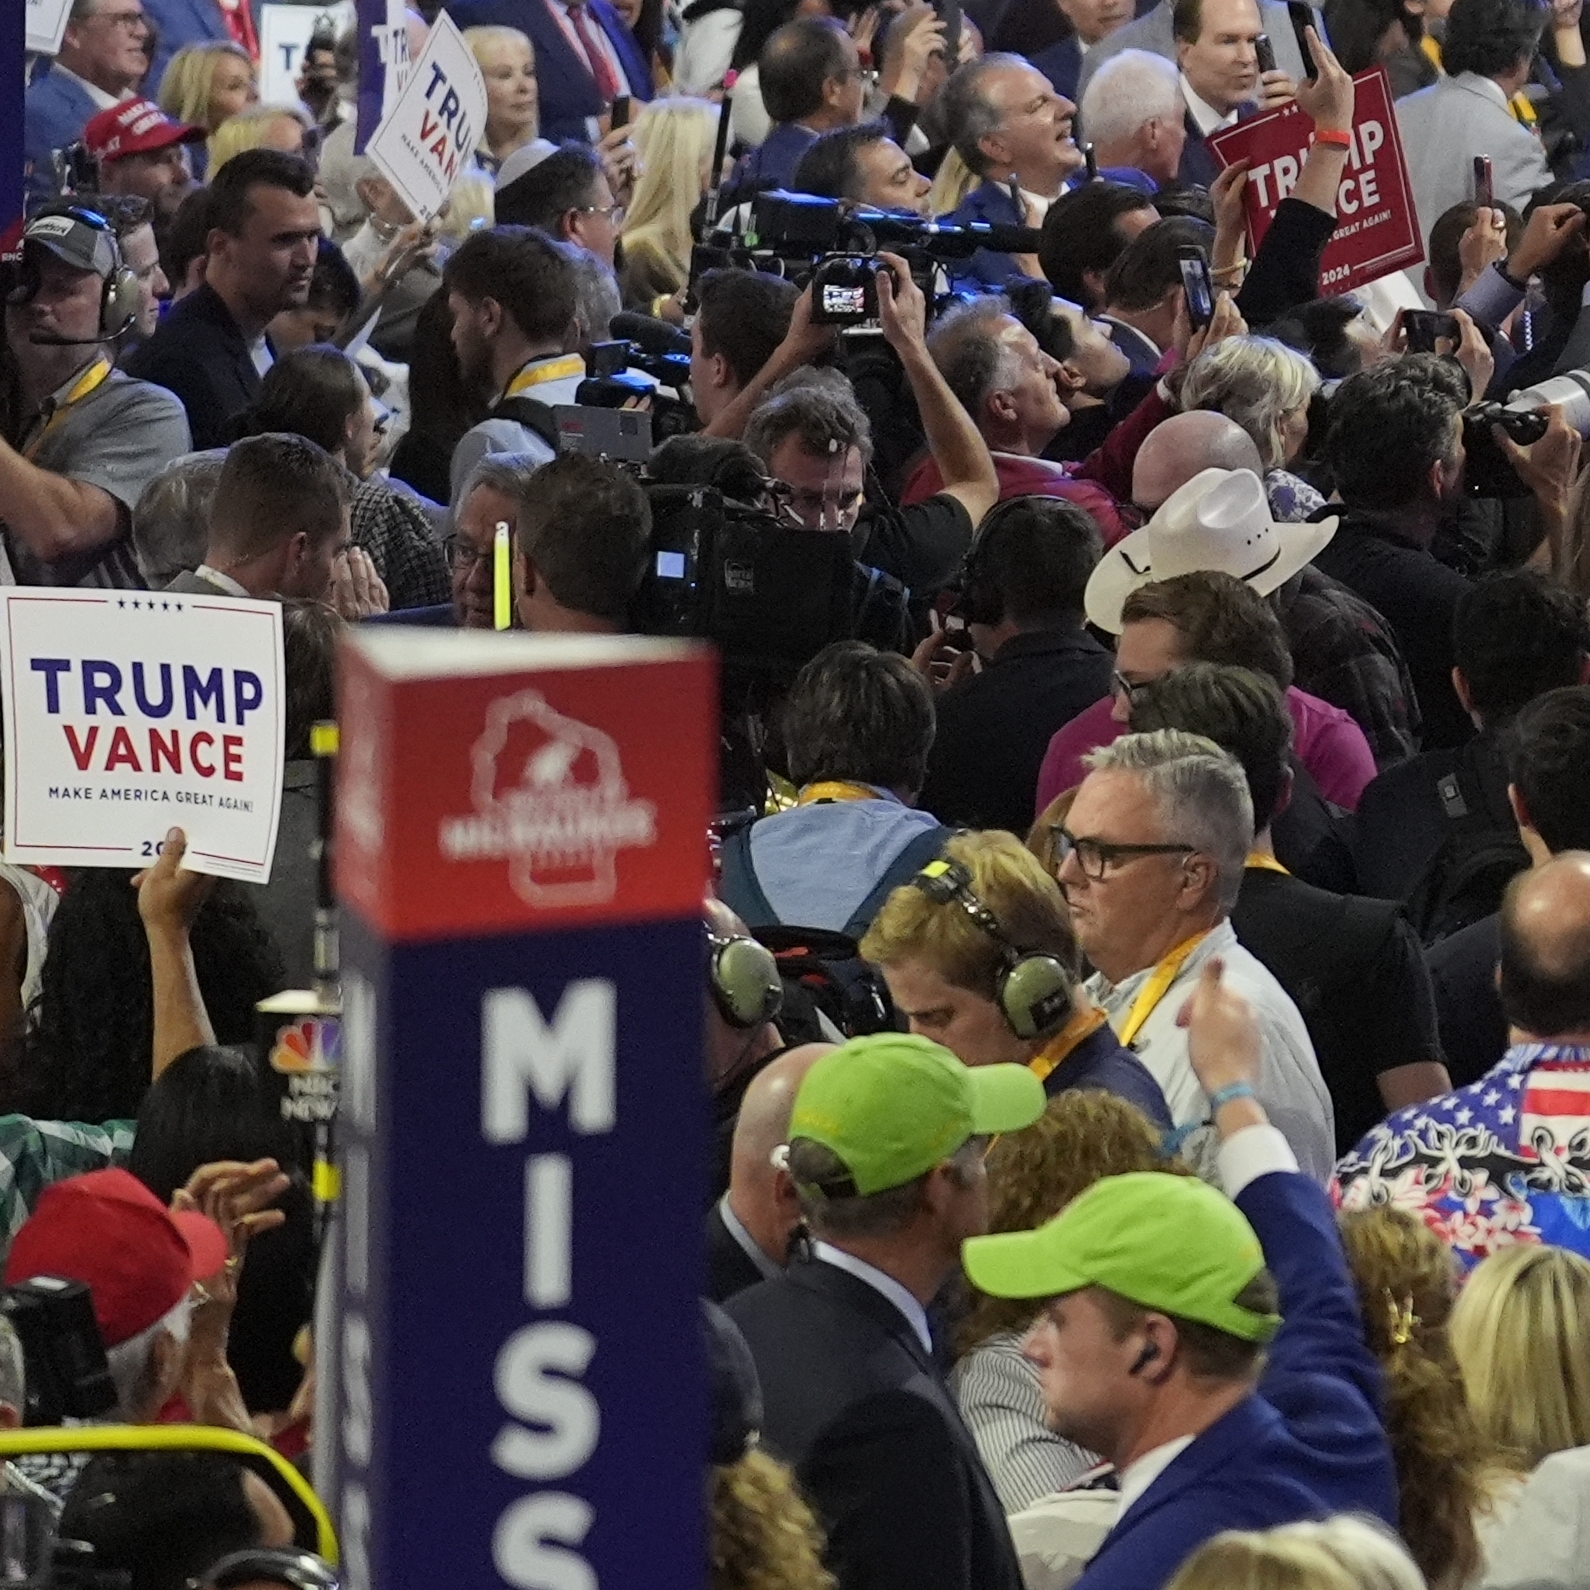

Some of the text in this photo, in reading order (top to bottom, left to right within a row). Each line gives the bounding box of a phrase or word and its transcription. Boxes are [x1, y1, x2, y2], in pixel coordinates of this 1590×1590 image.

[424, 60, 473, 154] TRU
[419, 109, 458, 181] VAN
[1247, 119, 1384, 208] TRP
[1333, 209, 1392, 243] GREAT AGAIN!
[1321, 263, 1351, 286] 2024
[30, 658, 263, 726] TRUMP
[62, 724, 244, 782] VANCE
[49, 787, 254, 813] MAKE AMERICA GREAT AGAIN!
[479, 977, 618, 1590] MISS
